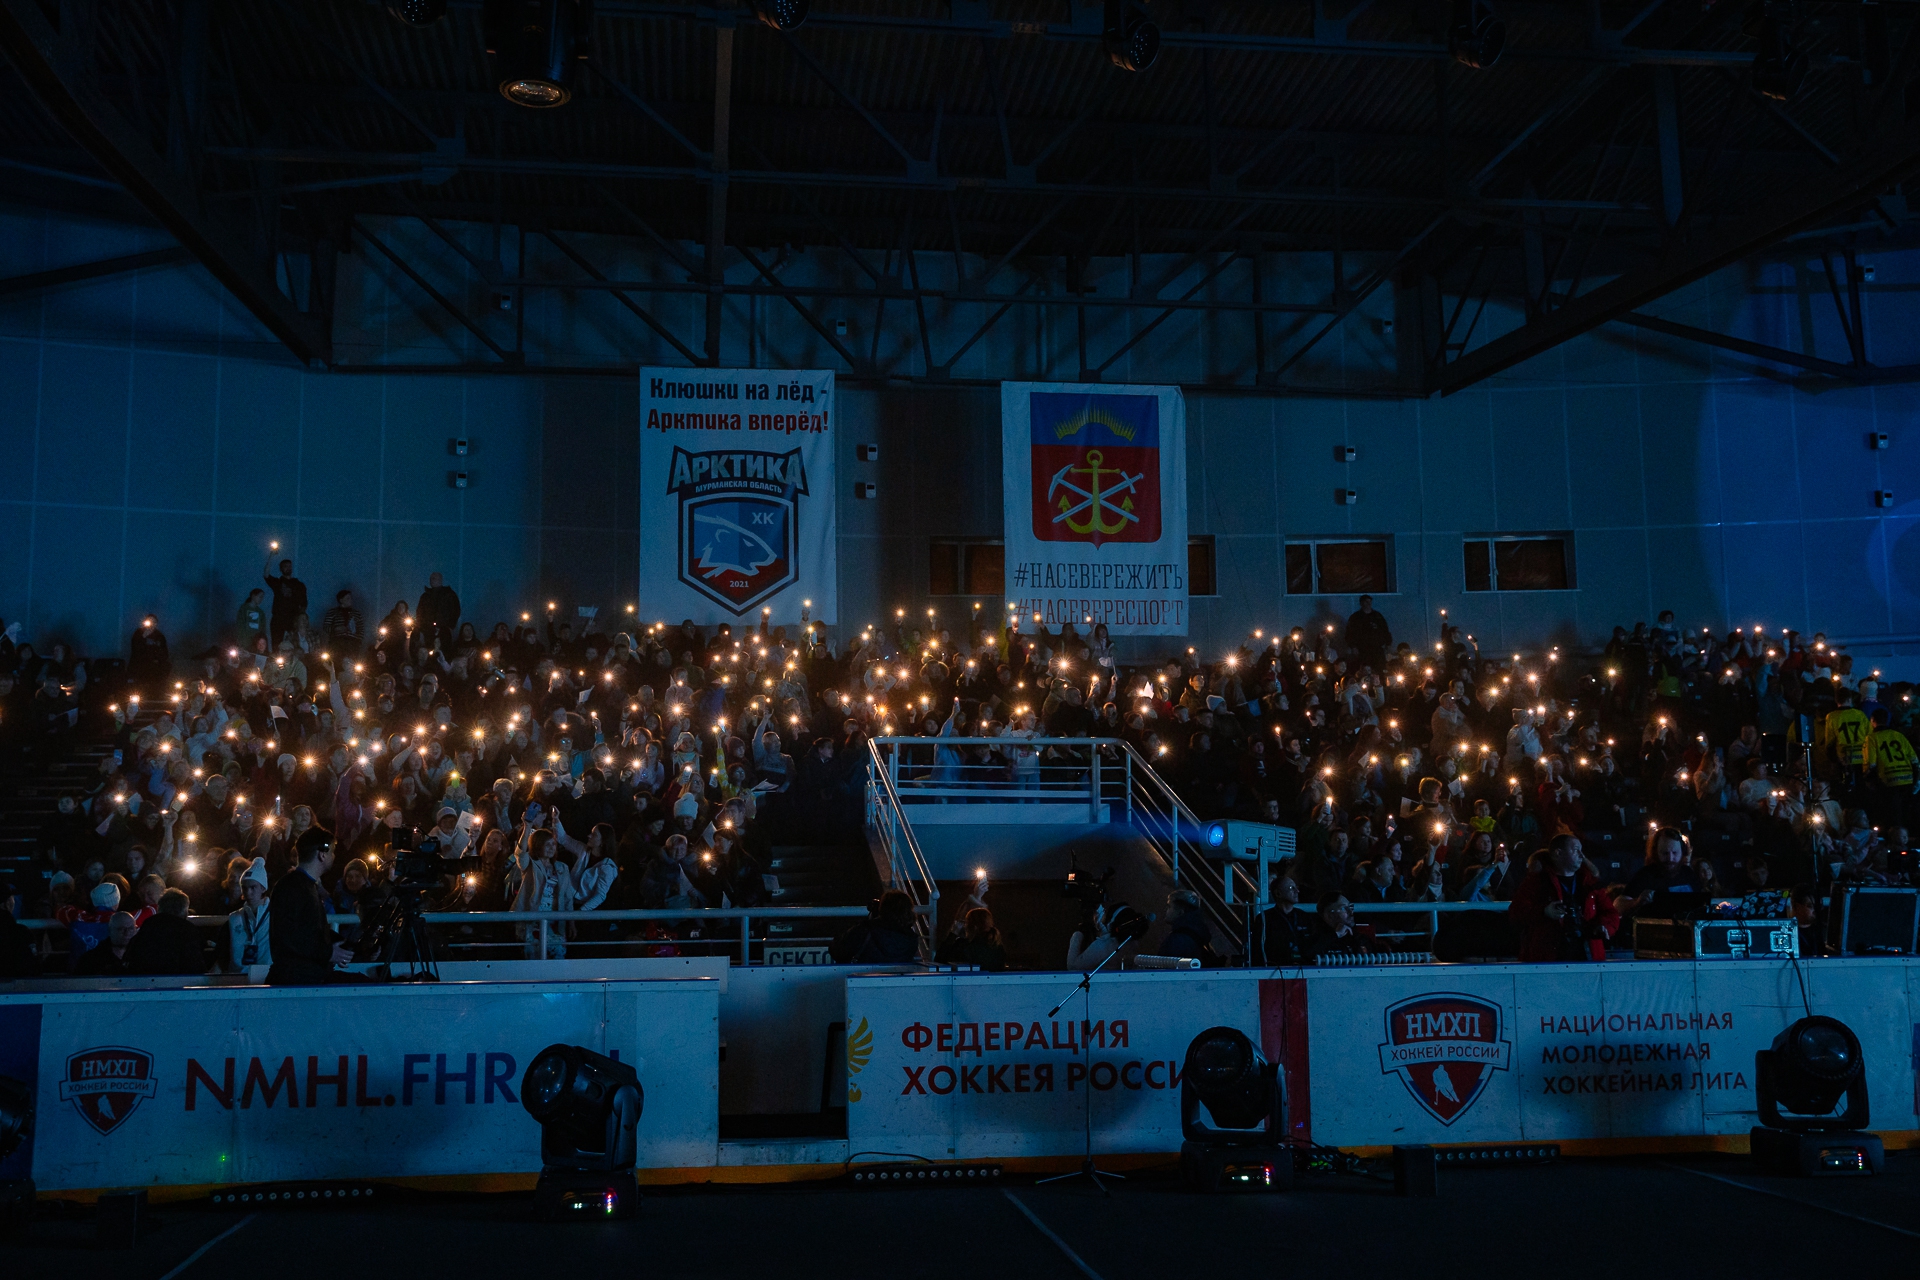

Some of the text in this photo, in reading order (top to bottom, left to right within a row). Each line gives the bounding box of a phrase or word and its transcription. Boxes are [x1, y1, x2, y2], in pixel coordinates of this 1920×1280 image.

[650, 378, 738, 400] Клюшки
[745, 383, 769, 400] на
[776, 381, 814, 403] лёд
[647, 409, 829, 435] Арктика вперёд!
[671, 449, 805, 491] АРКТИКА
[695, 480, 782, 494] МУРМАНСКАЯ ОБЛАСТЬ
[729, 580, 749, 588] 2021
[1014, 563, 1182, 589] #НАСЕВЕРЕЖИТЬ
[1838, 722, 1860, 743] 17
[1880, 740, 1905, 762] 13
[1405, 1011, 1482, 1040] НМХЛ
[1540, 1011, 1733, 1036] НАЦИОНАЛЬНАЯ
[902, 1019, 1130, 1057] ФЕДЕРАЦИЯ
[1391, 1045, 1501, 1061] ХОККЕЙ РОССИИ
[1541, 1042, 1711, 1066] МОЛОДЕЖНАЯ
[81, 1058, 137, 1078] НМХЛ
[902, 1064, 1054, 1096] ХОККЕЯ
[110, 1081, 149, 1090] РОССИИ
[1543, 1069, 1748, 1095] ХОККЕЙНАЯ ЛИГА
